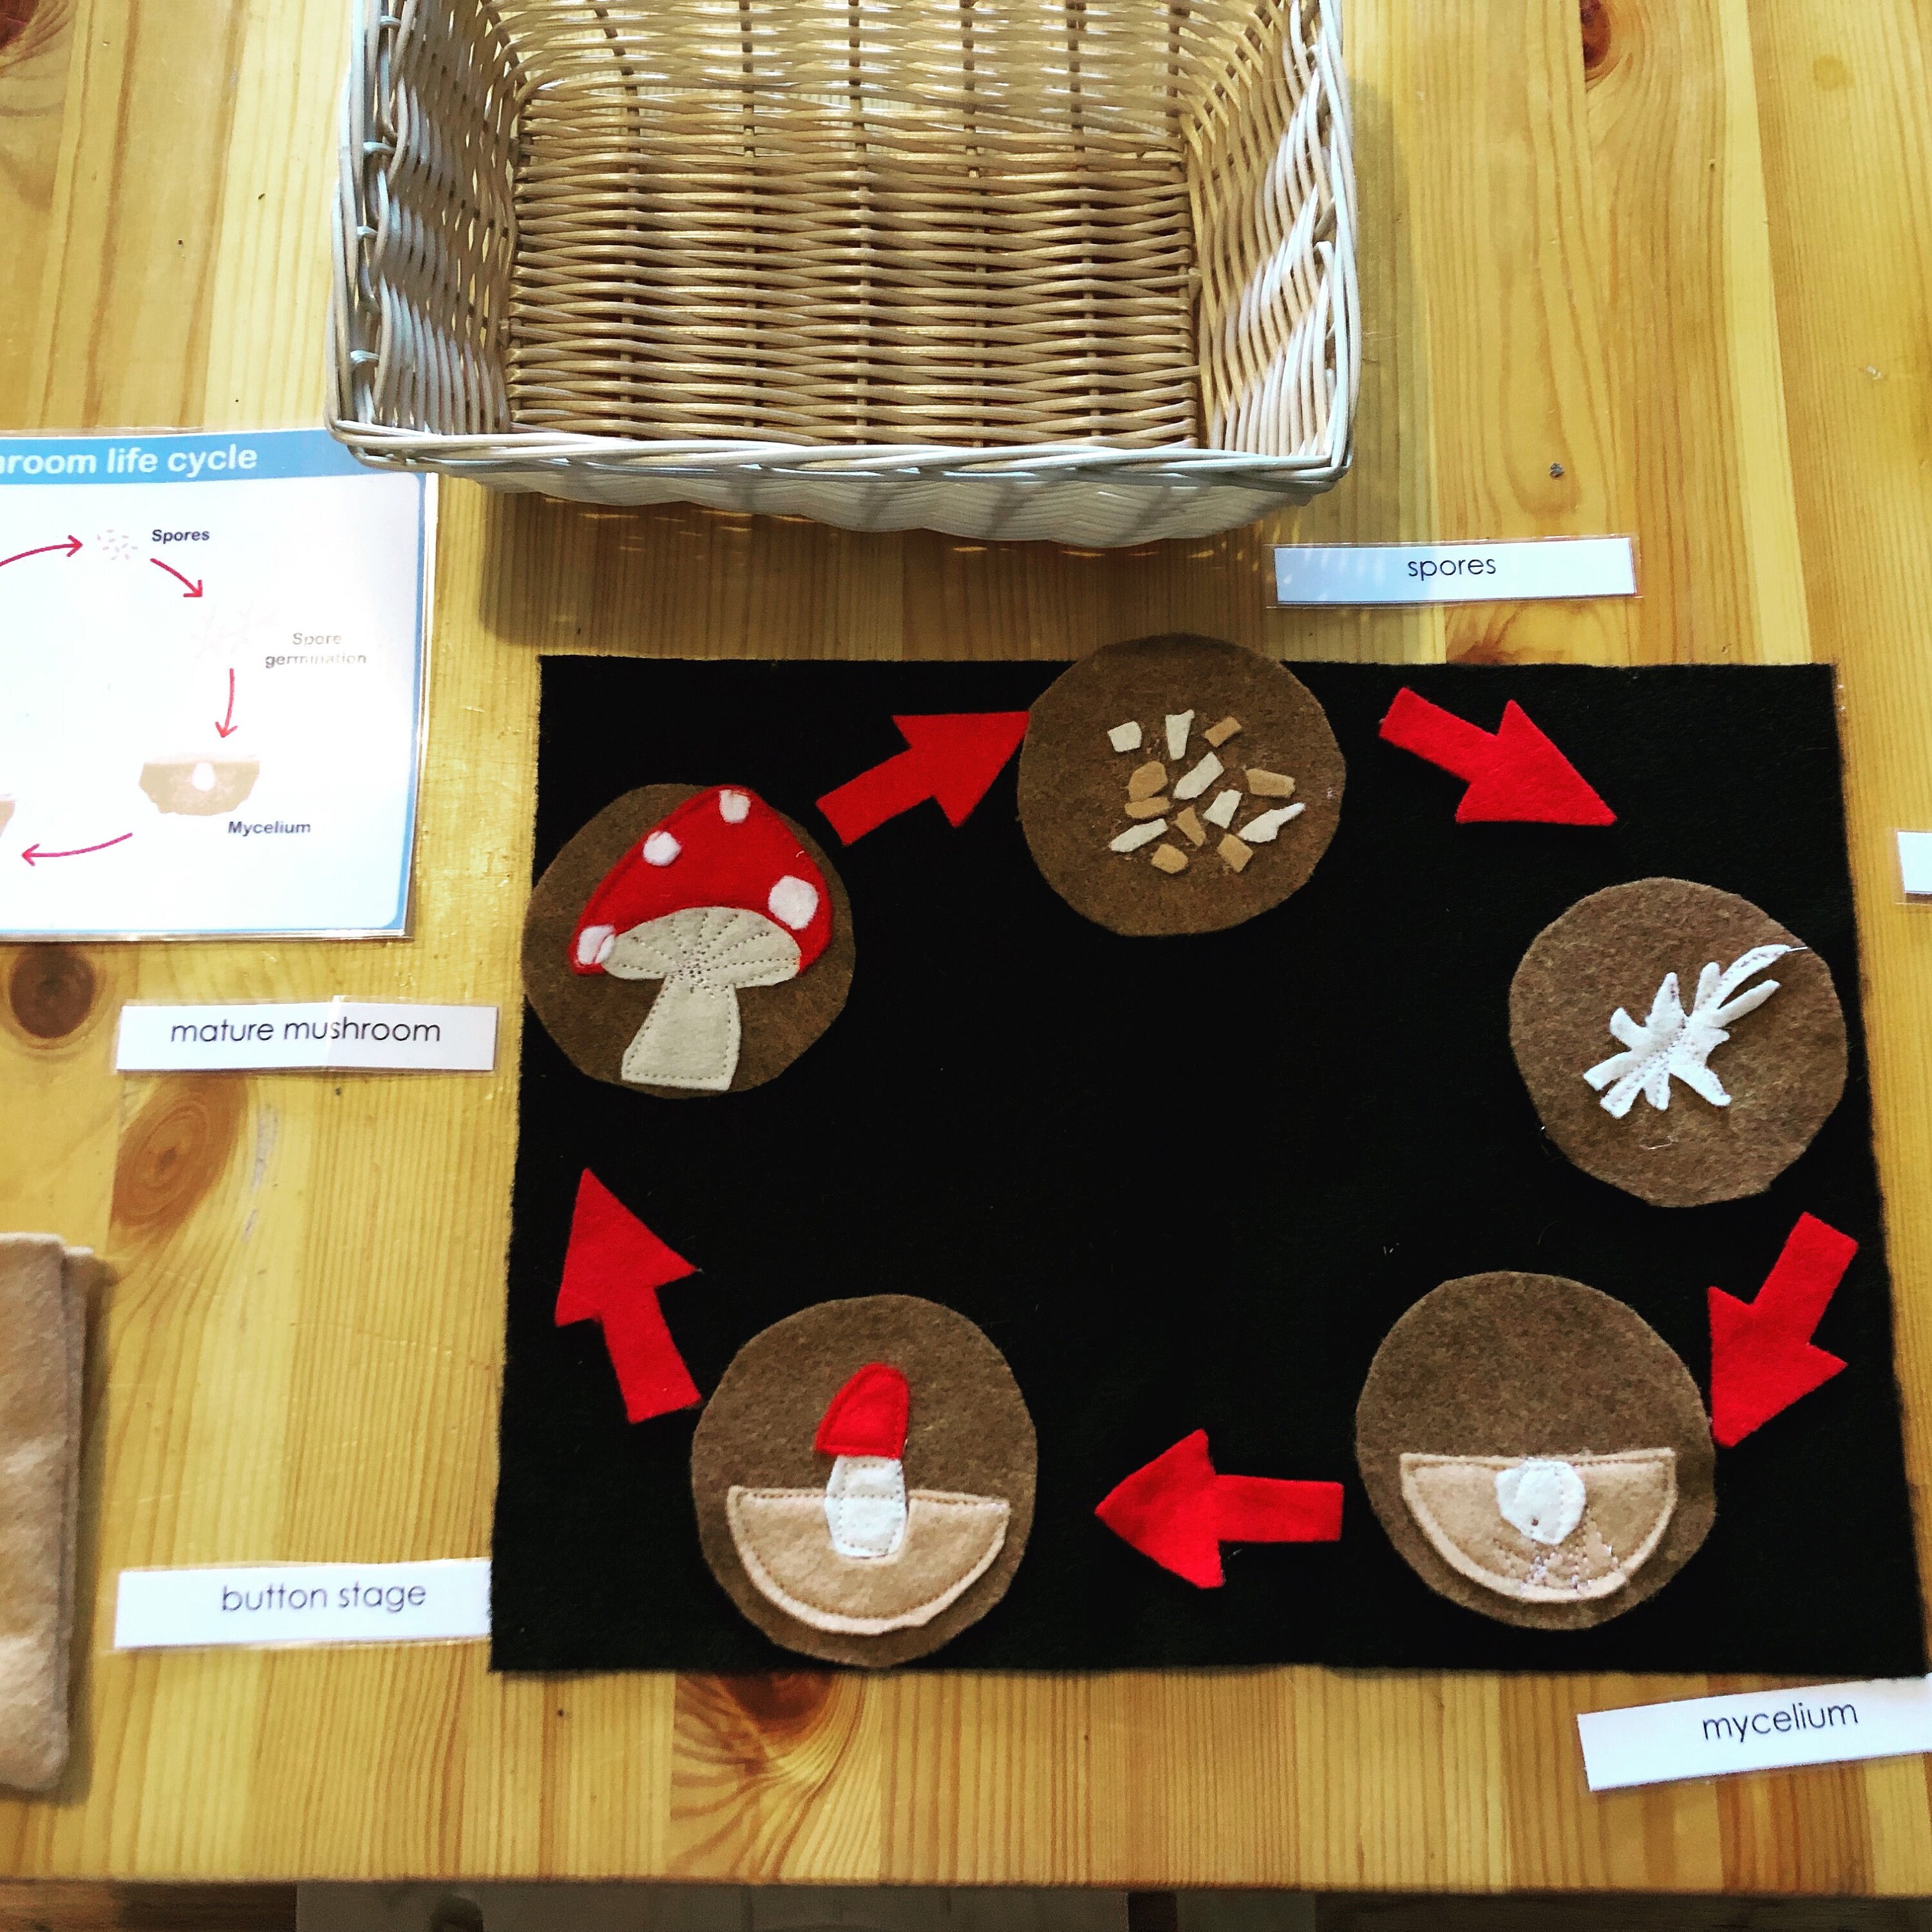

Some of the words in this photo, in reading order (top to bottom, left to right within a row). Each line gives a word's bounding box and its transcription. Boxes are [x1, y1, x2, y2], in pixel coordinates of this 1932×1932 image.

[107, 447, 158, 474] life
[167, 443, 258, 478] cycle
[151, 529, 210, 544] Spores
[1407, 558, 1497, 581] spores
[292, 632, 342, 646] Spore
[265, 653, 367, 668] germination
[228, 820, 312, 836] Mycelium
[171, 1019, 274, 1042] mature
[283, 1016, 441, 1041] mushroom
[222, 1583, 327, 1612] button
[338, 1580, 426, 1613] stage
[1702, 1702, 1859, 1743] mycelium
